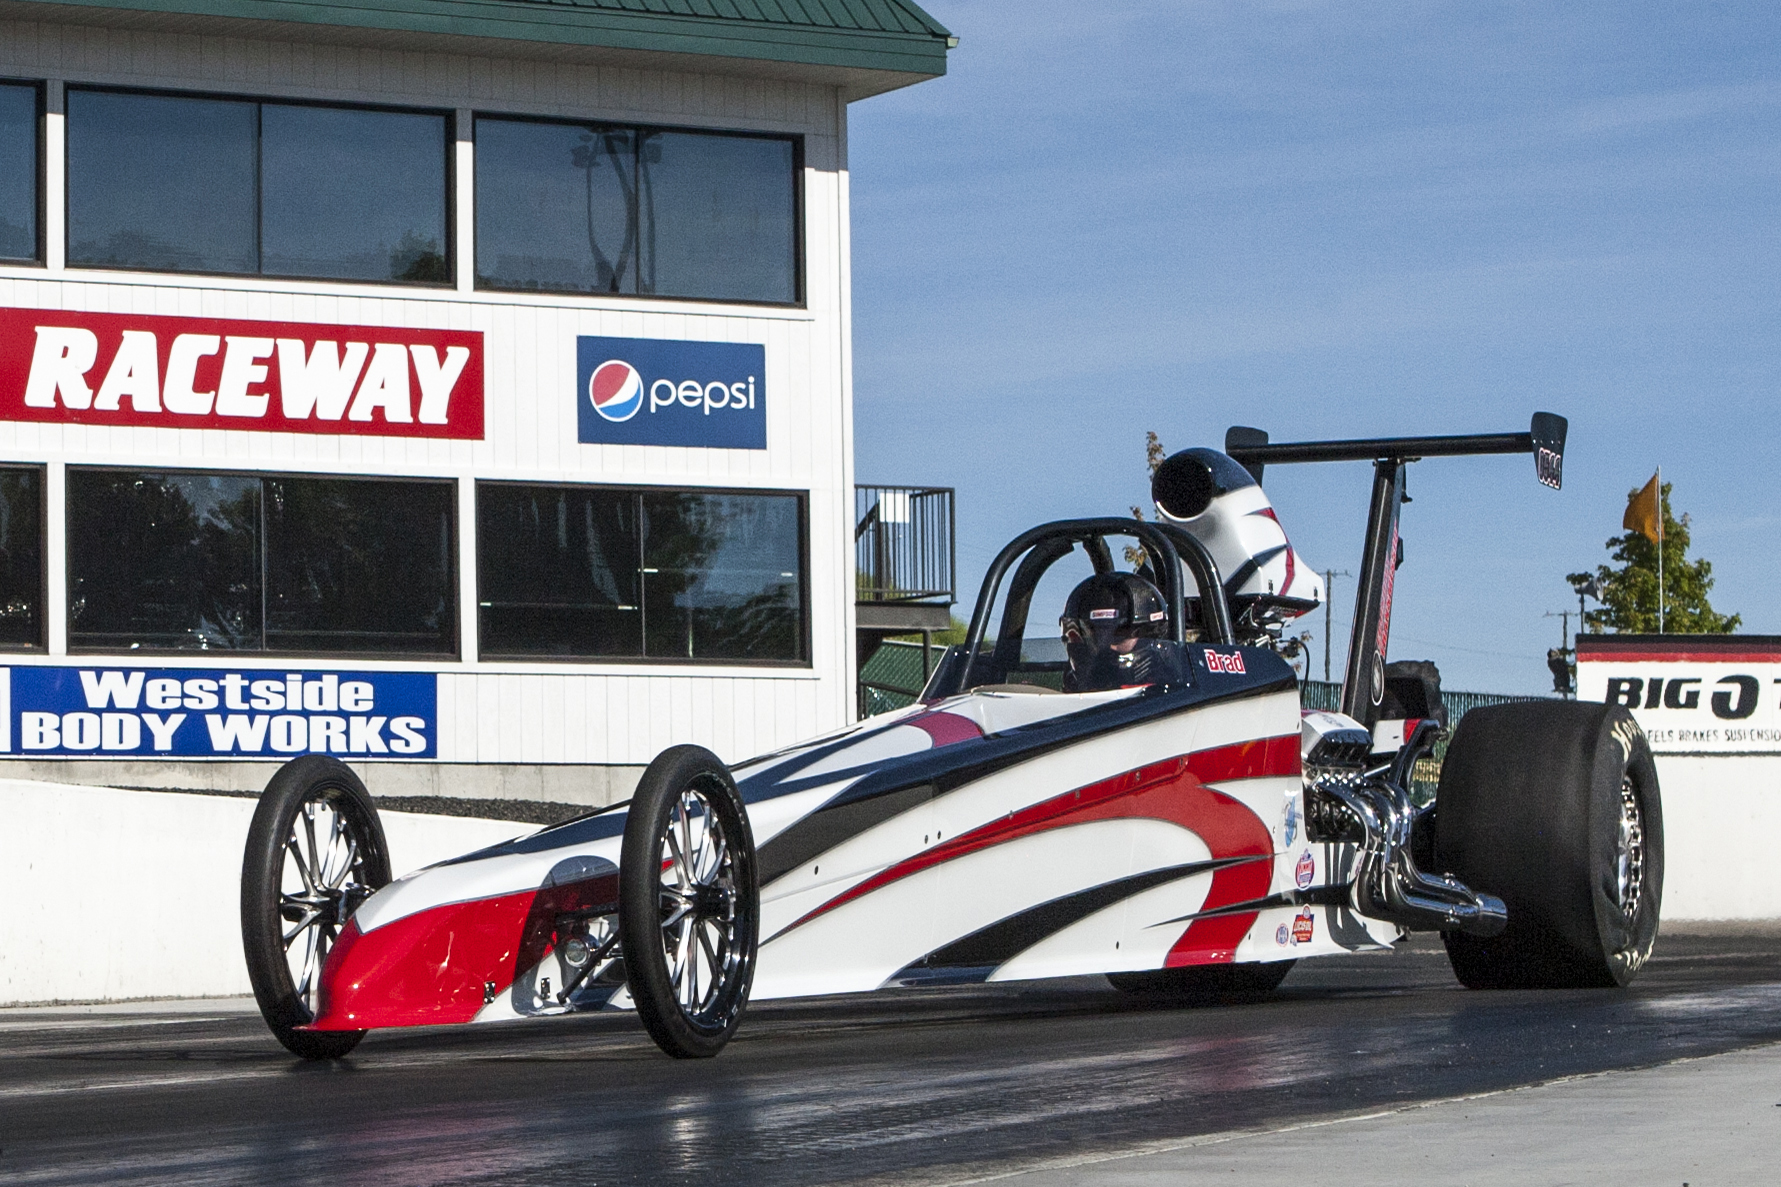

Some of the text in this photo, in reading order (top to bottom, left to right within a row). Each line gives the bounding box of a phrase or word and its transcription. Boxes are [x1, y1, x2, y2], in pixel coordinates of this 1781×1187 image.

[24, 325, 470, 424] RACEWAY
[650, 376, 755, 415] pepsi
[1204, 649, 1246, 674] Brad
[79, 671, 374, 711] Westside
[1605, 677, 1702, 709] BIG
[1711, 674, 1760, 720] O
[21, 711, 427, 754] BODY WORKS
[1644, 729, 1674, 743] EELS
[1679, 729, 1719, 742] BRAKES
